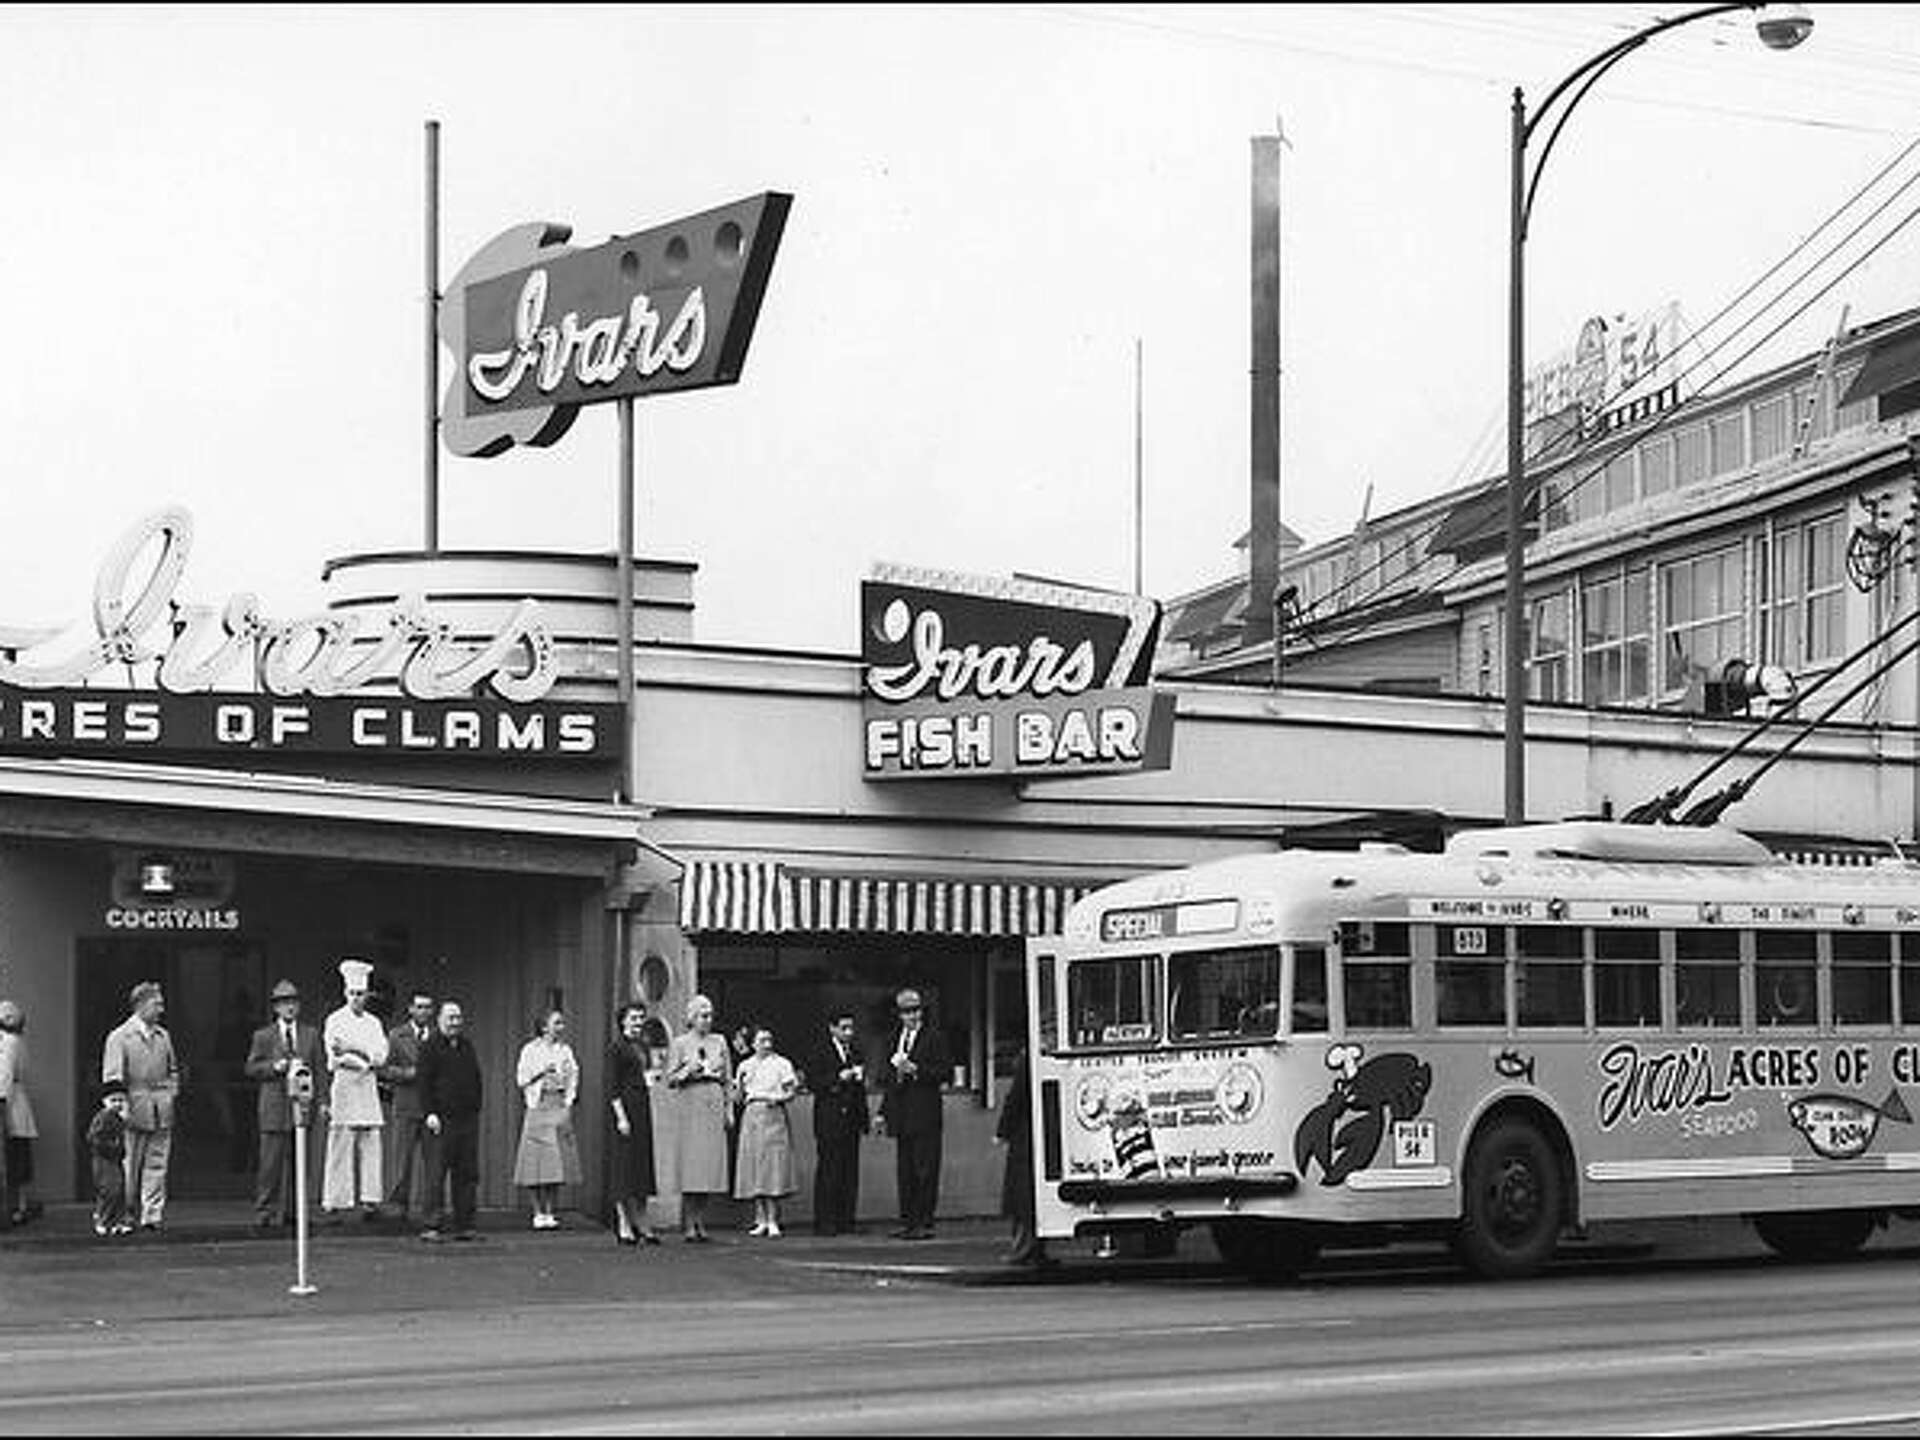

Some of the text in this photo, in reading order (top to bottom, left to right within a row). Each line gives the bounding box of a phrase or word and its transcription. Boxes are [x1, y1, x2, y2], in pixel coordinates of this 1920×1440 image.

[0, 699, 597, 752] RES OF CLAMS
[866, 705, 1140, 769] FISH BAR
[105, 908, 240, 930] COCKTAILS
[1726, 1048, 1819, 1087] ACRES
[1835, 1047, 1870, 1085] OF
